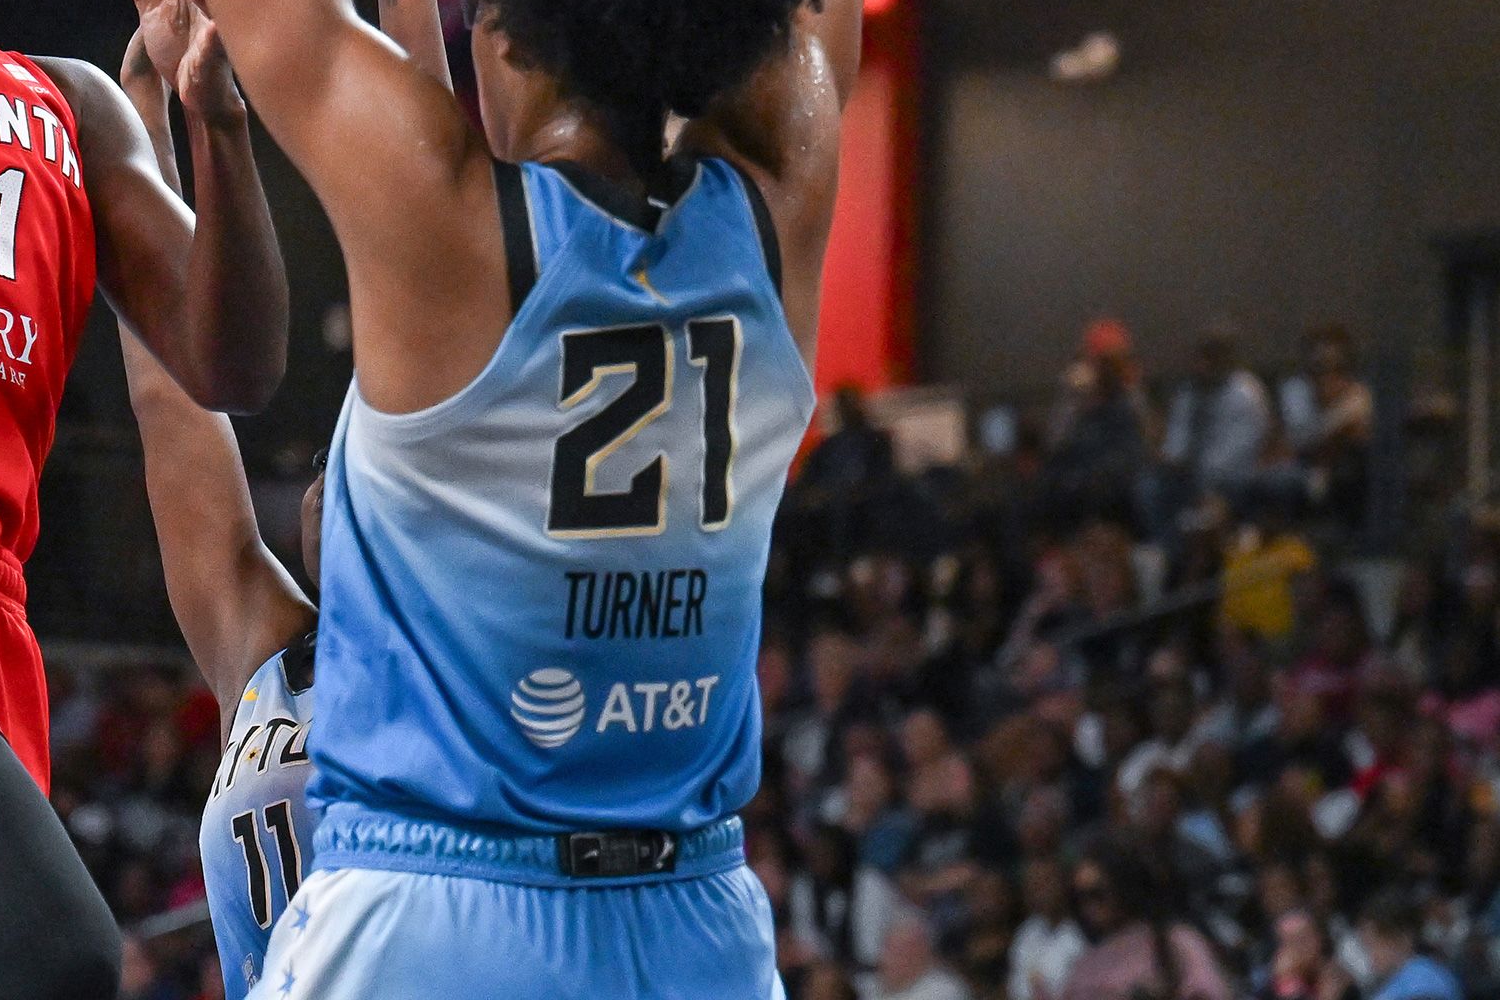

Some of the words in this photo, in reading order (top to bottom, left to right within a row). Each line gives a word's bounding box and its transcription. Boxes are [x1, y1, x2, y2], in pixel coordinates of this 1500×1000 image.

[544, 313, 743, 540] 21
[563, 567, 708, 640] TURNER
[596, 674, 720, 734] AT&T
[231, 799, 304, 930] 11
